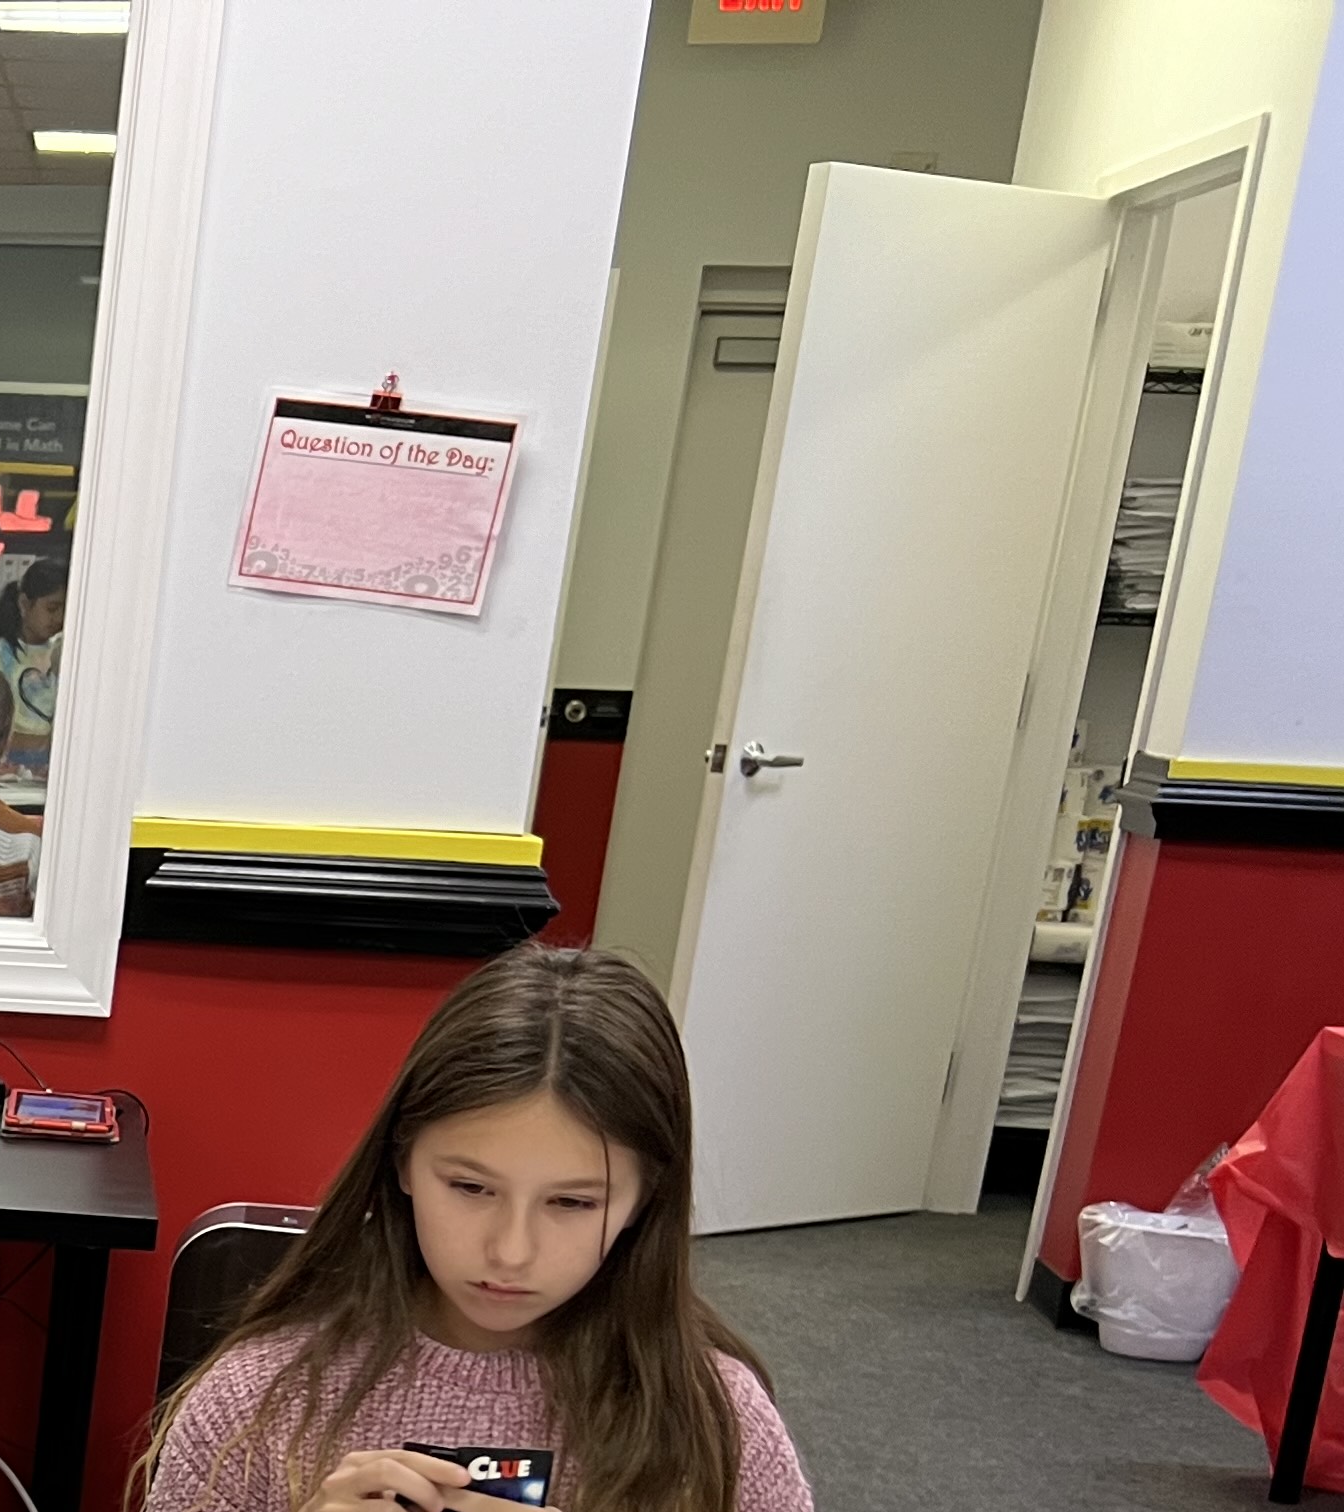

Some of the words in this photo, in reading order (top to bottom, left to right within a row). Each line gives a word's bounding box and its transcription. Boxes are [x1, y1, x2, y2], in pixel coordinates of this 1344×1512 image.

[26, 417, 57, 431] Can
[6, 438, 20, 450] in
[24, 438, 63, 451] Math
[280, 429, 373, 457] Question
[379, 442, 403, 464] of
[407, 445, 439, 466] the
[446, 447, 496, 476] Day:
[467, 1456, 532, 1481] CLUE
